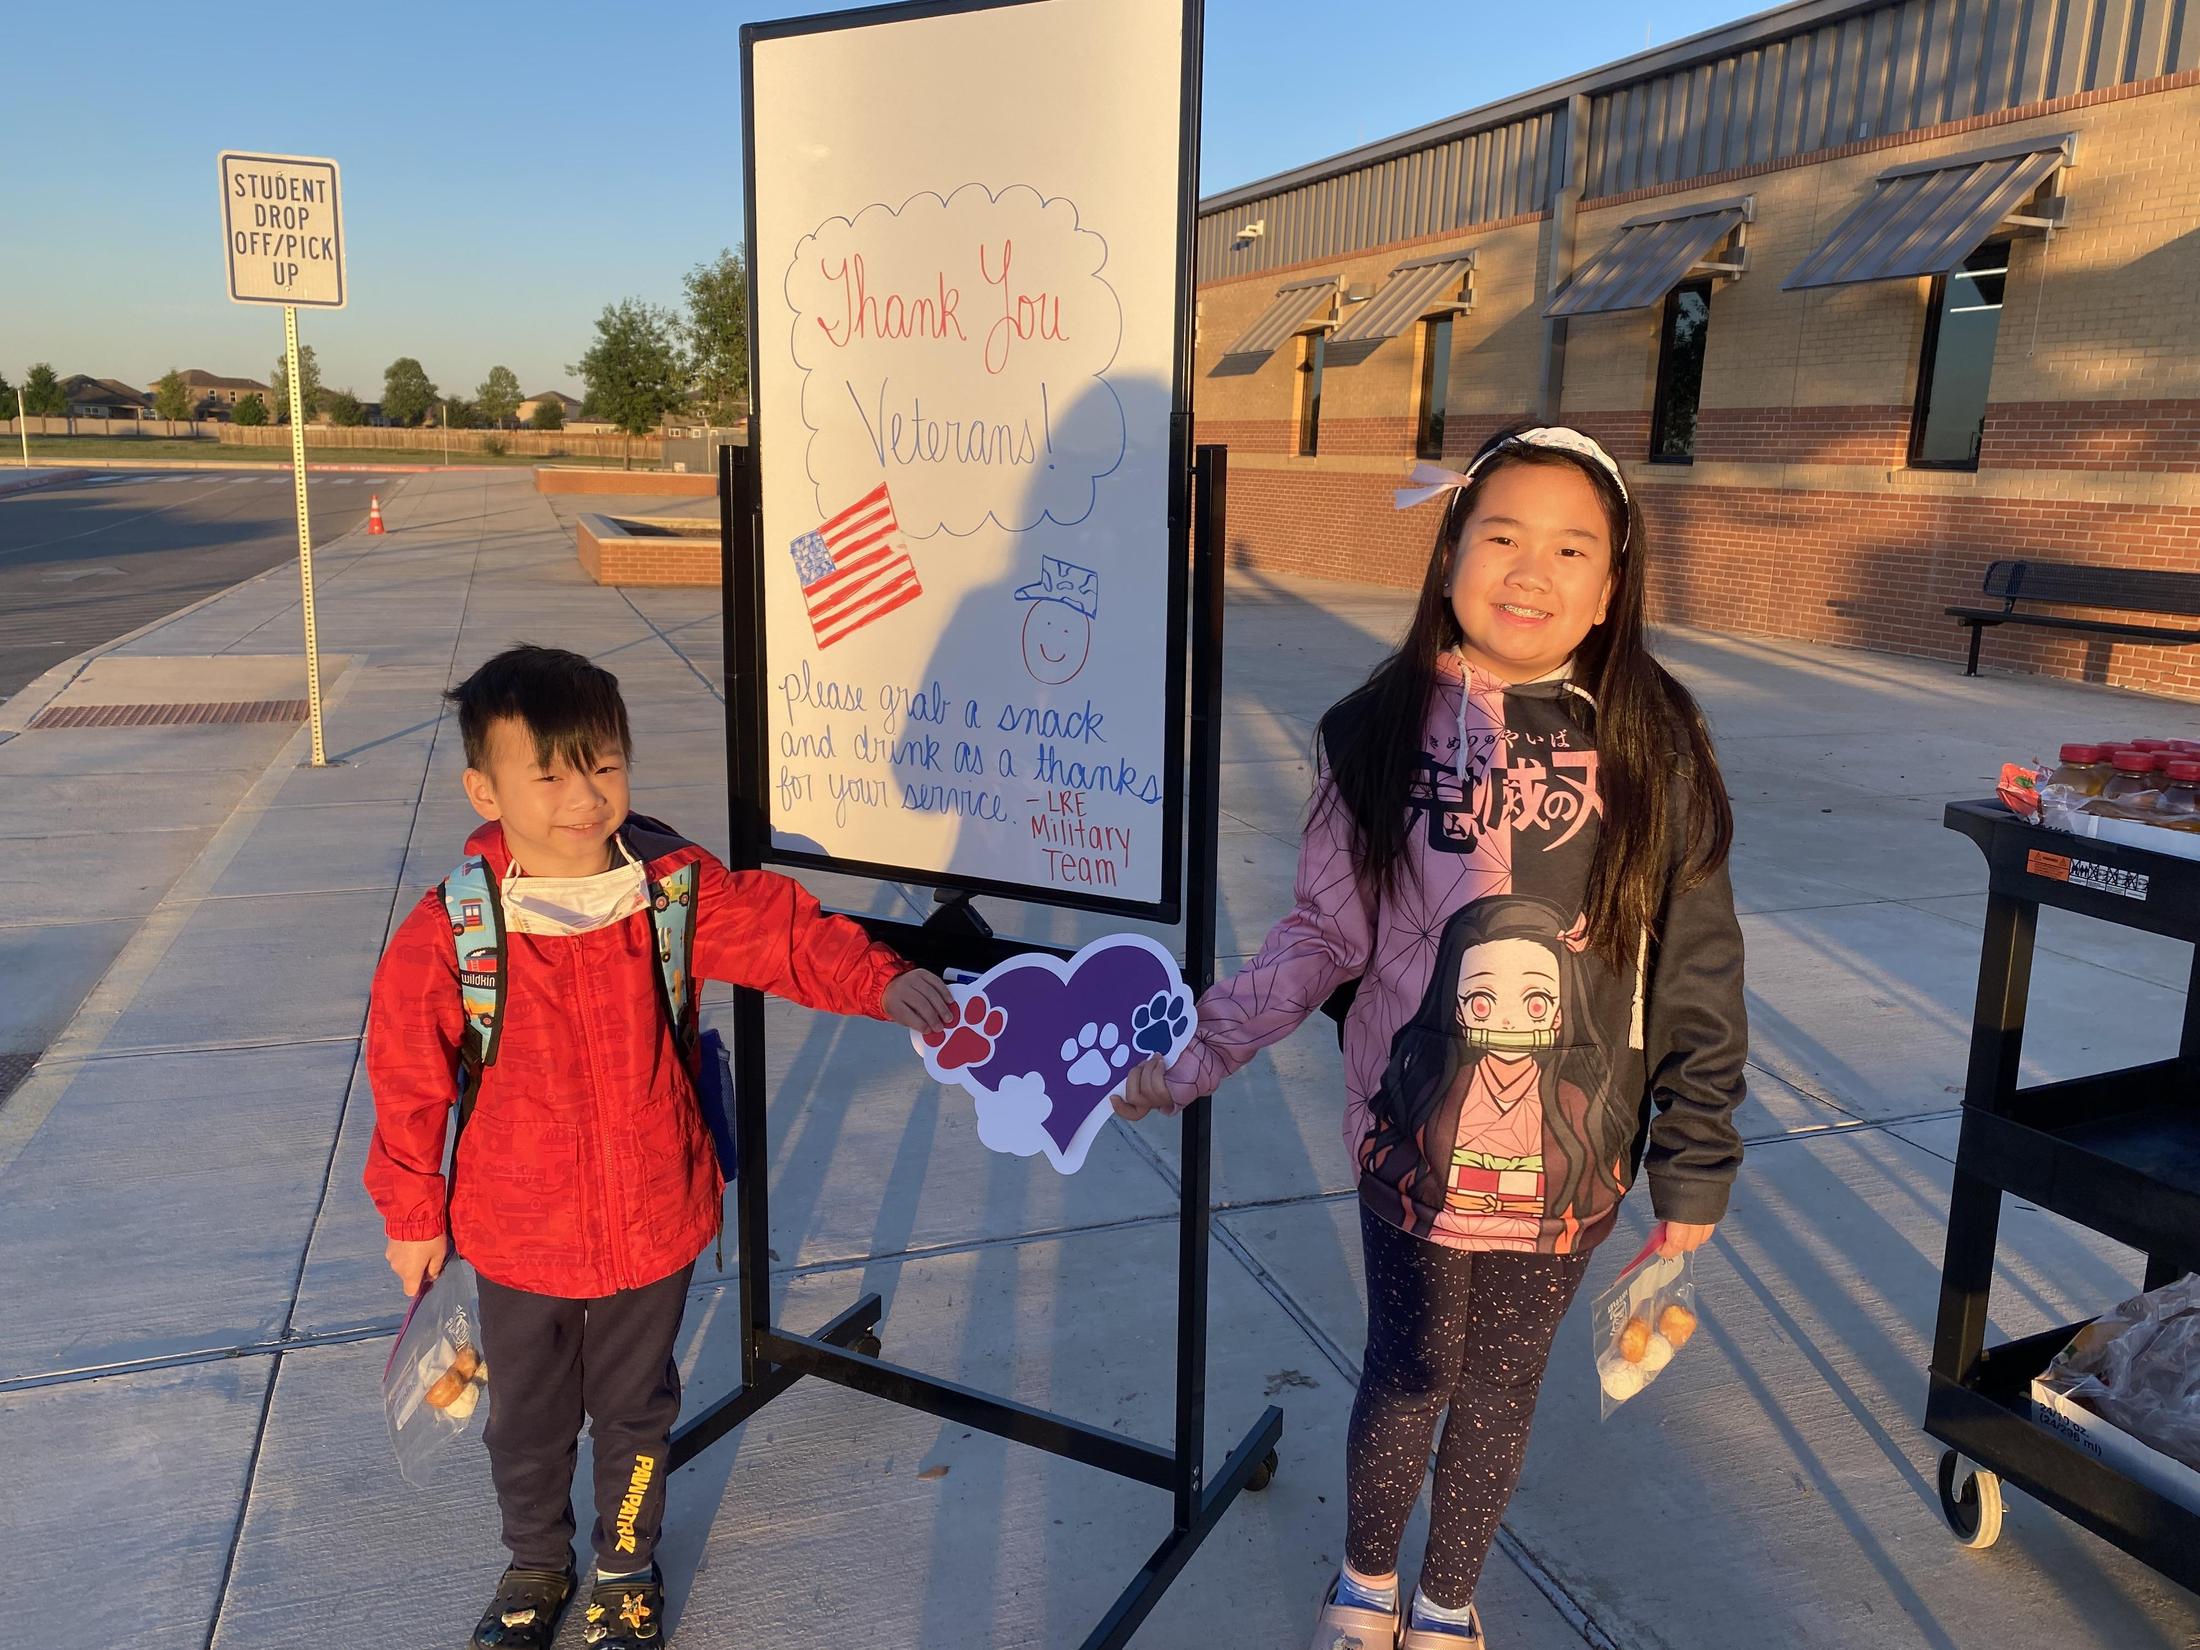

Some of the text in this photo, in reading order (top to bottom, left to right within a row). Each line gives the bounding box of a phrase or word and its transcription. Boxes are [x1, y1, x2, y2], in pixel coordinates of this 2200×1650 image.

[234, 173, 326, 203] STUDENT
[255, 204, 309, 230] DROP
[235, 231, 333, 261] OFF/PICK
[273, 262, 299, 286] UP
[817, 239, 1070, 374] Thank You
[846, 377, 1055, 470] Veterans!
[779, 659, 1107, 744] please grab a snack
[780, 725, 1163, 804] and drink as a thanks
[777, 765, 1016, 828] for your service.
[1031, 814, 1131, 868] Military
[1042, 848, 1117, 886] Team
[461, 973, 496, 987] wildkin
